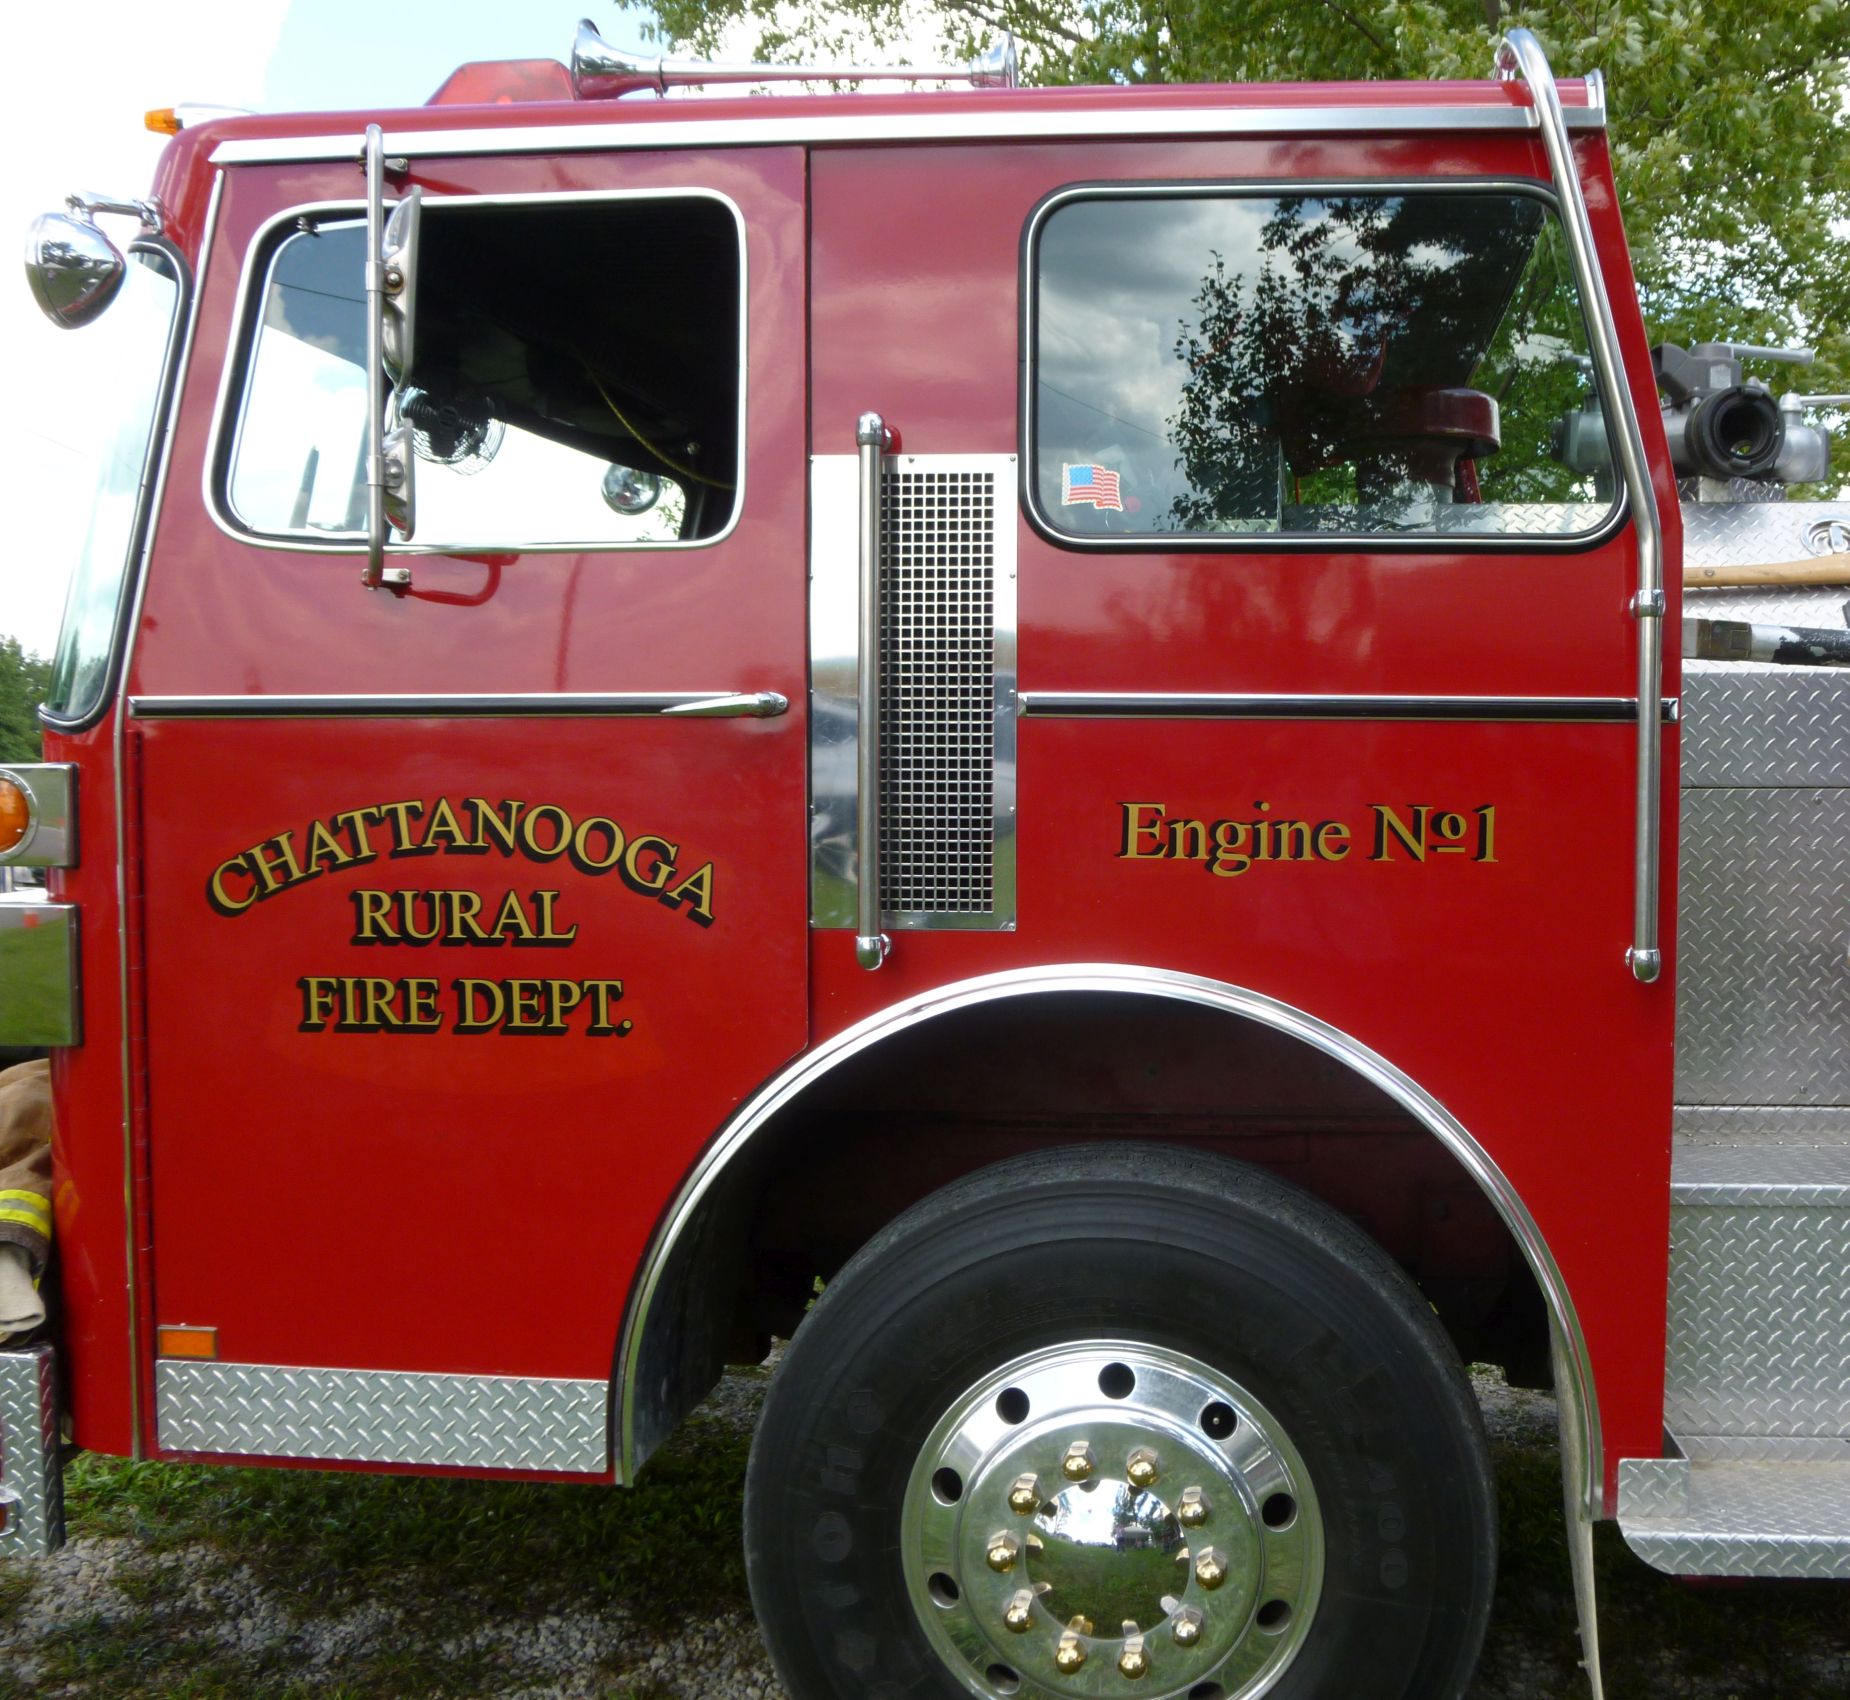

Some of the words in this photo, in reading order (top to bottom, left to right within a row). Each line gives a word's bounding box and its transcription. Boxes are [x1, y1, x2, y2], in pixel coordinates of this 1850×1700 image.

[207, 797, 717, 927] CHATTANOOGA
[1115, 801, 1352, 878] Engine
[350, 890, 578, 946] RURAL
[298, 977, 444, 1033] FIRE
[453, 979, 634, 1036] DEPT.
